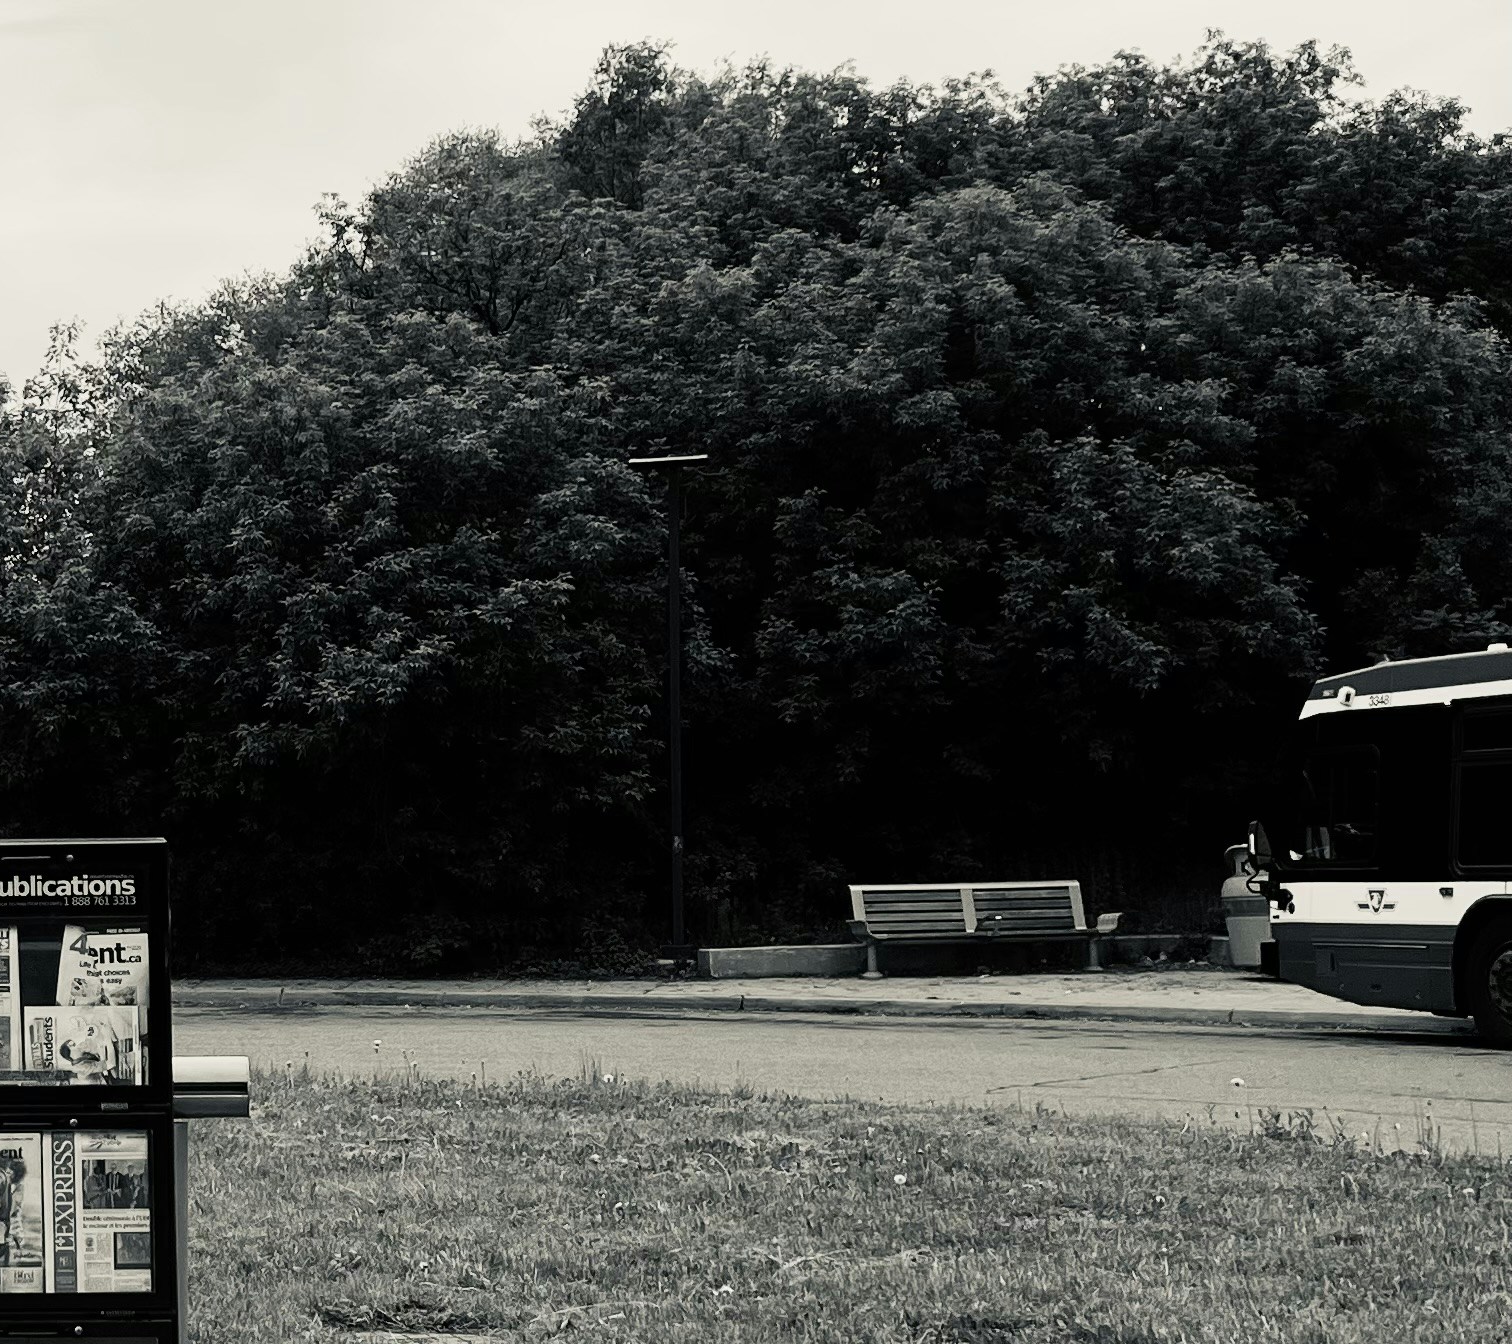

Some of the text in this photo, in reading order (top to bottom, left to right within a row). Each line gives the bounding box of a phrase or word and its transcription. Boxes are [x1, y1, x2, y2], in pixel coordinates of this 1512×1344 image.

[63, 896, 137, 906] 1 888 761 3313
[43, 1016, 54, 1070] Students
